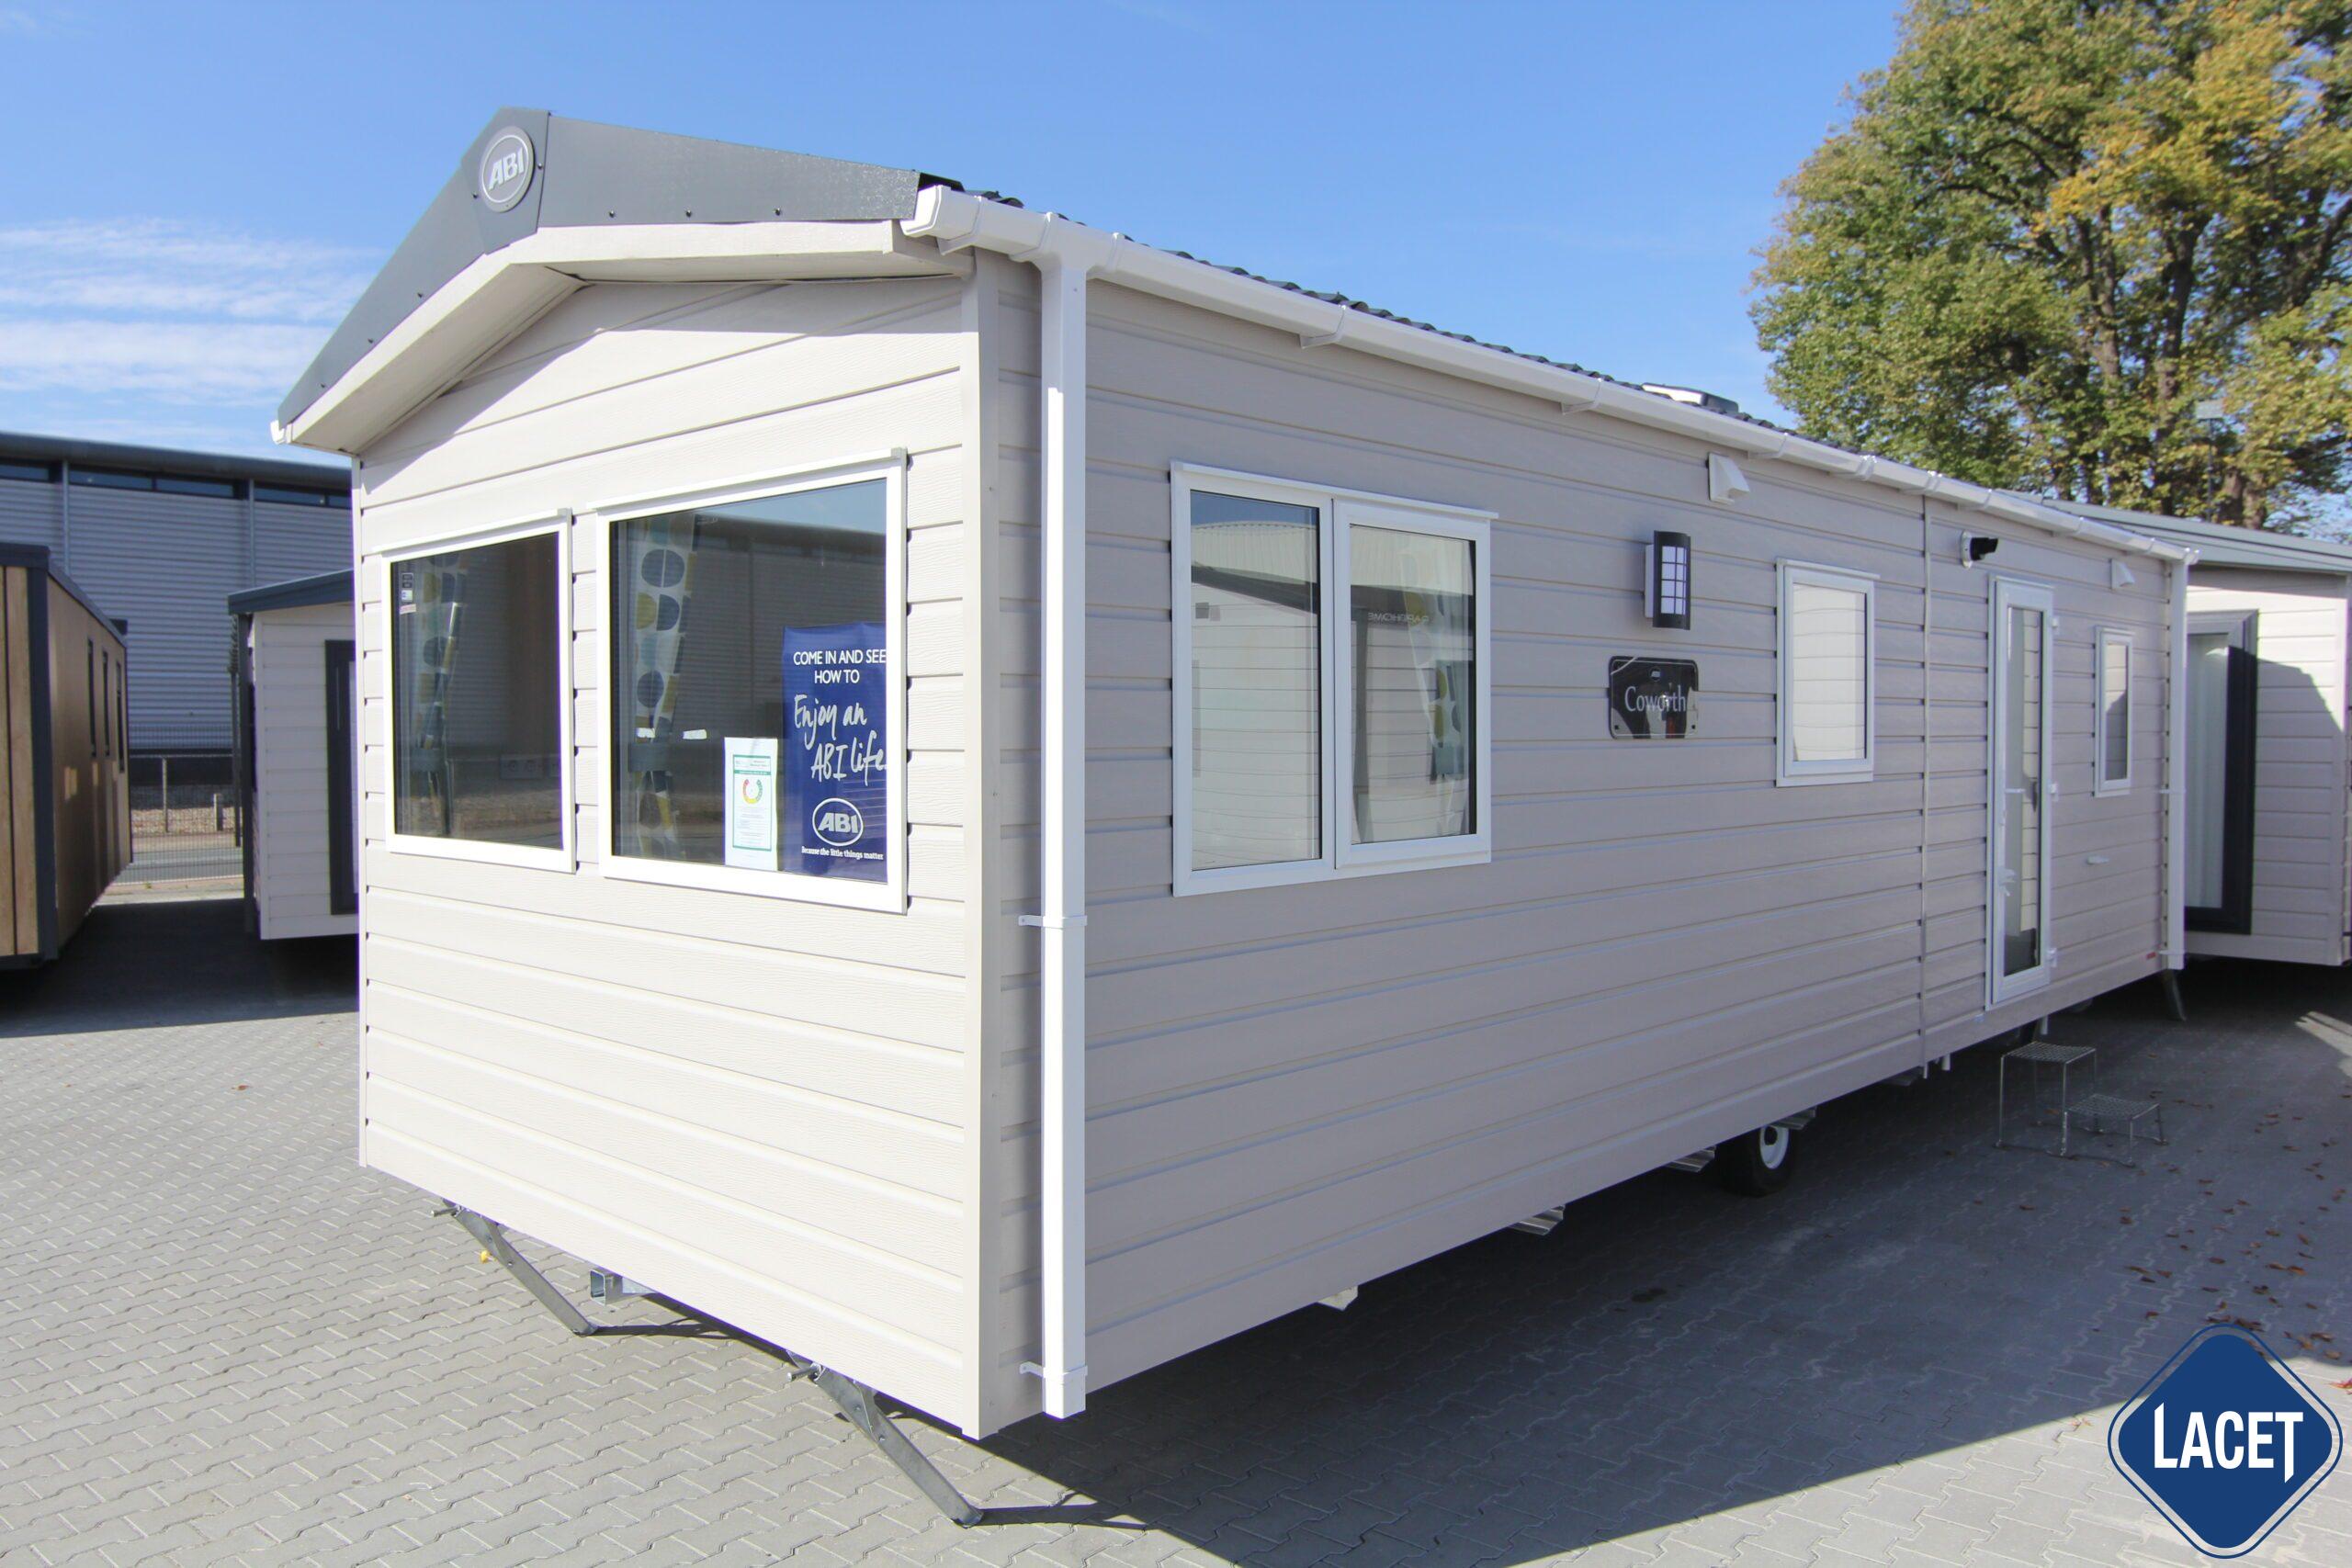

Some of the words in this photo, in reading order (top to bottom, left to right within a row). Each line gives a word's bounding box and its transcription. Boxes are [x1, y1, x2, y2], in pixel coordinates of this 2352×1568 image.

[488, 147, 525, 191] ABI
[793, 651, 823, 665] COME
[825, 650, 837, 665] IN
[838, 649, 864, 664] AND
[865, 649, 887, 664] SEE
[814, 670, 842, 684] HOW
[842, 670, 860, 683] TO
[1624, 684, 1686, 712] Coworth
[794, 694, 838, 750] Enjoy
[842, 702, 868, 727] an
[810, 742, 849, 783] ABI
[817, 811, 859, 834] ABI
[820, 847, 831, 856] the
[830, 848, 844, 858] little
[843, 849, 864, 861] things
